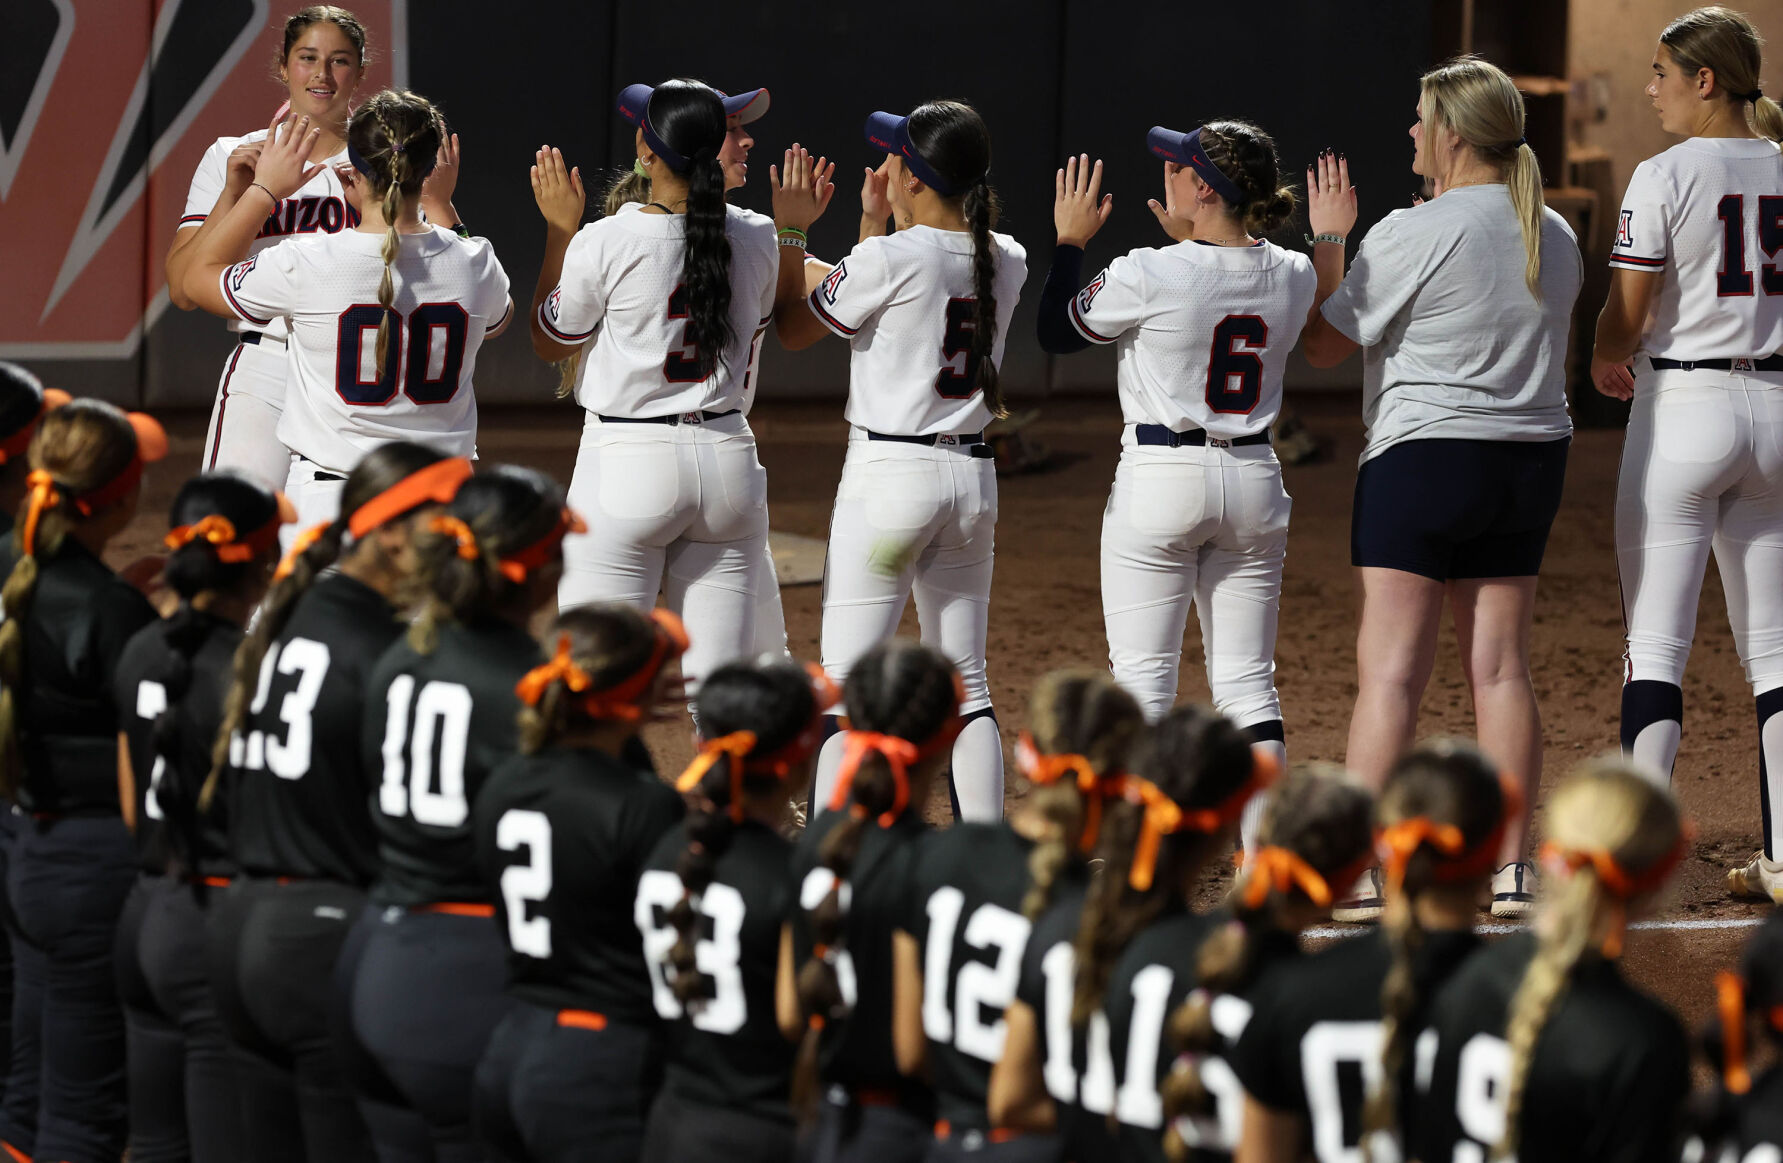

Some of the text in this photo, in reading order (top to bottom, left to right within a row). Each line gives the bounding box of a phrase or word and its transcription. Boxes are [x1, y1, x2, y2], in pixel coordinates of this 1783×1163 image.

[256, 196, 361, 239] RIZON
[335, 302, 468, 406] 00
[935, 298, 996, 399] 5
[1205, 314, 1268, 415] 6
[379, 674, 473, 827] 10
[497, 809, 553, 958] 2
[922, 886, 1032, 1063] 12
